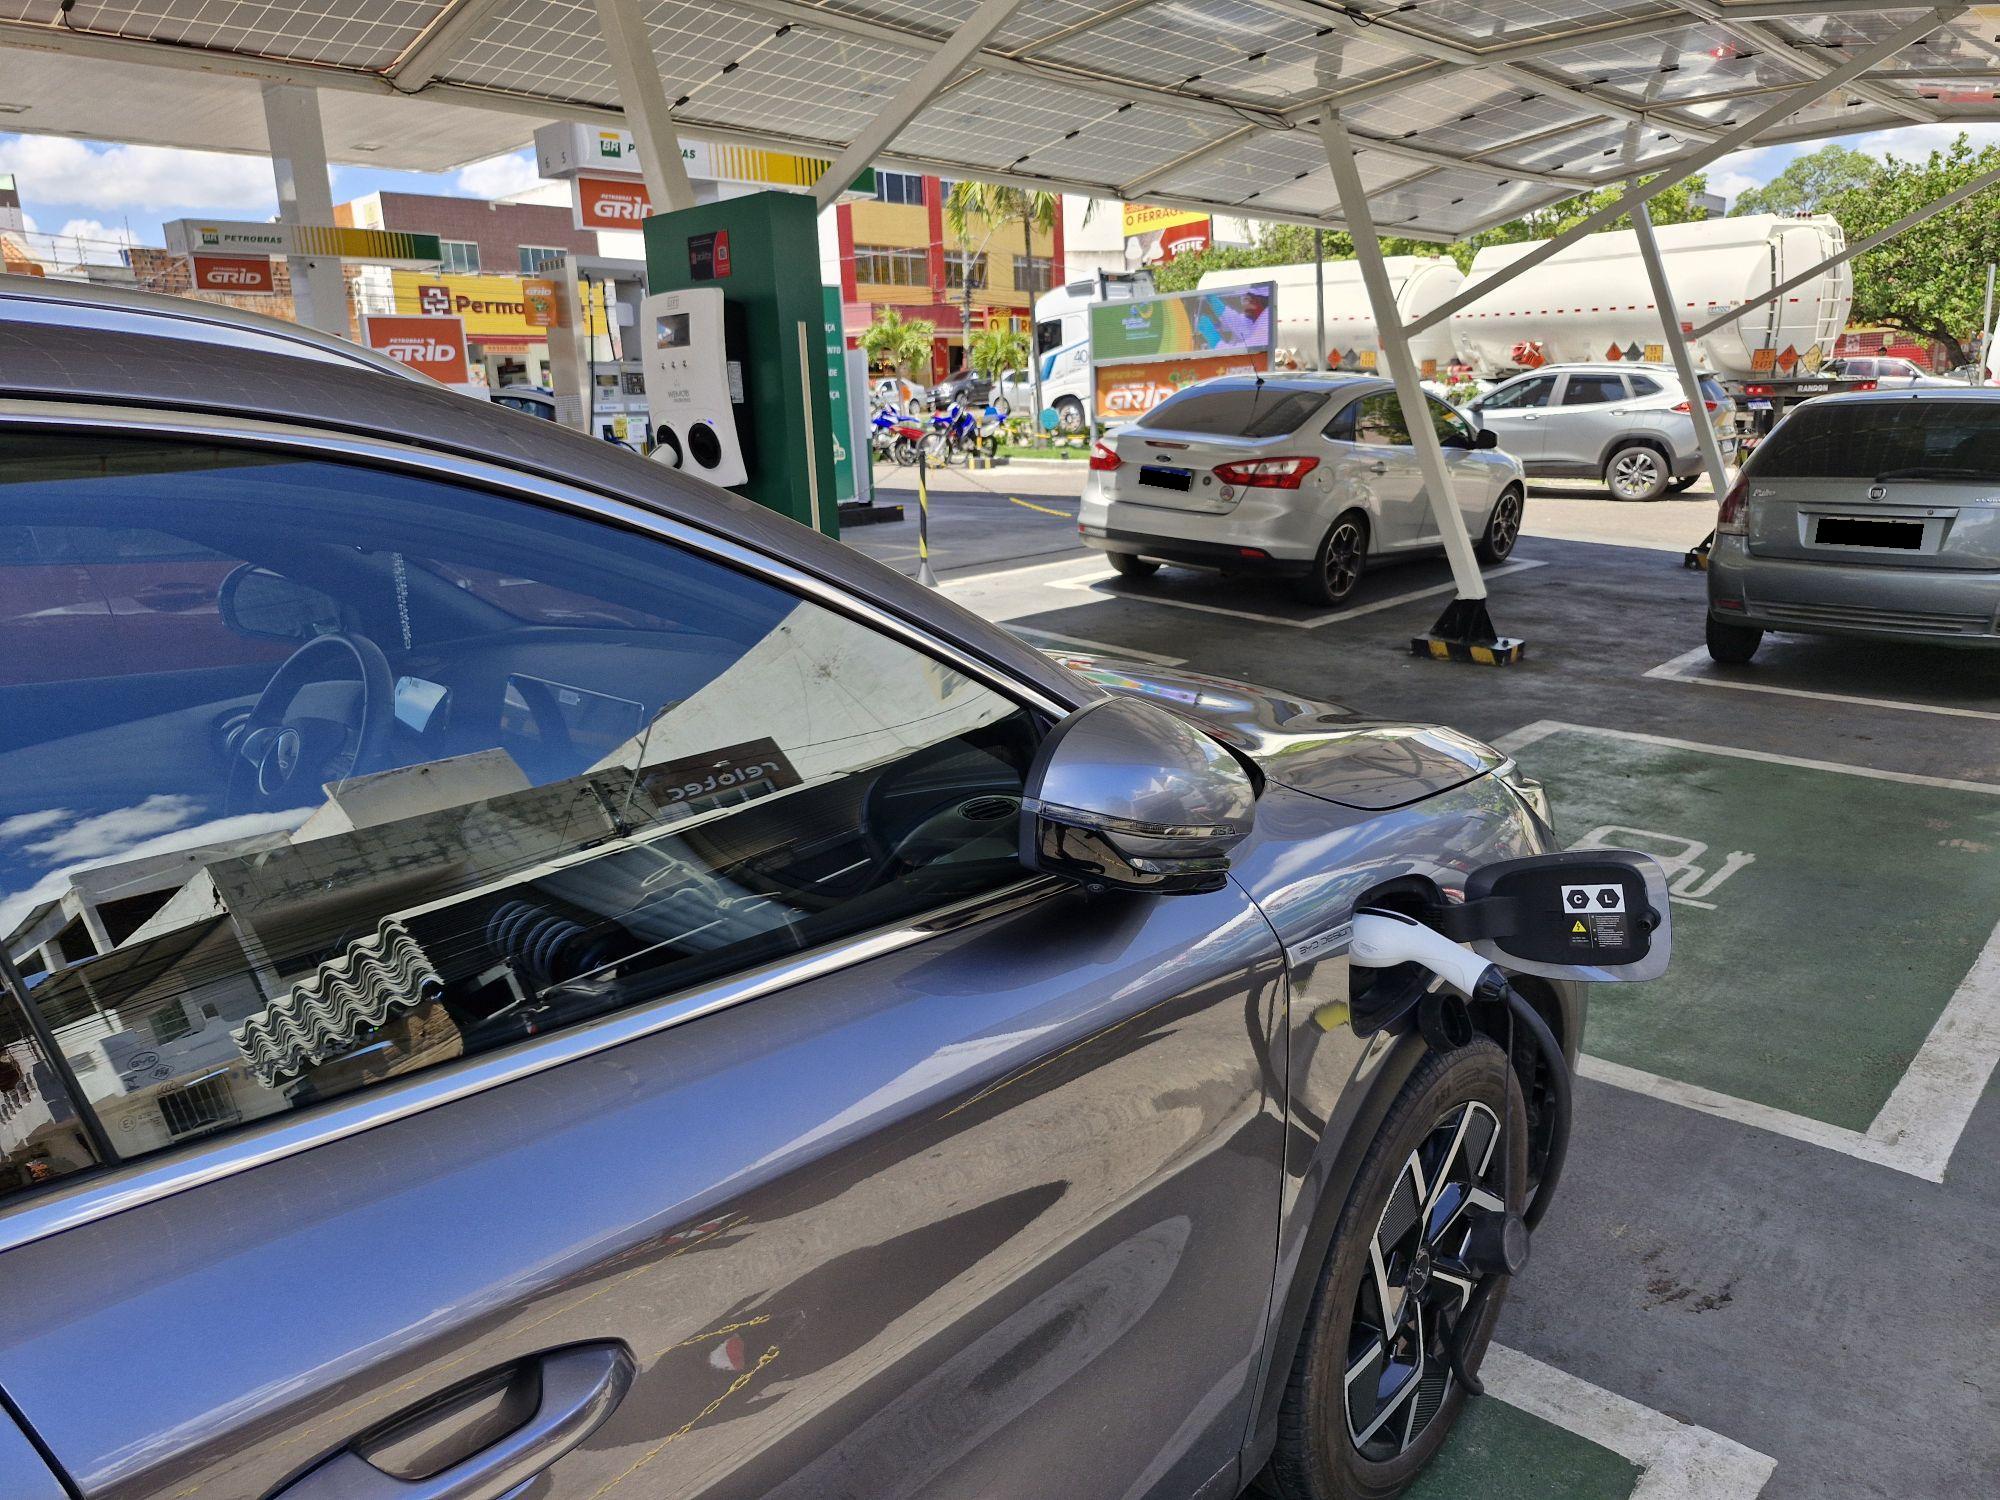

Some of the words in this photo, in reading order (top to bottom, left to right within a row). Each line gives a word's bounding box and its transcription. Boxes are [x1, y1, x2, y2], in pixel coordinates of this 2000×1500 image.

[224, 234, 282, 244] PETROBRAS
[207, 268, 261, 285] GRID
[389, 337, 425, 345] PETROBRAS
[384, 338, 456, 362] GRID
[1797, 384, 1829, 393] RANDON
[1573, 894, 1583, 904] C
[1604, 894, 1613, 904] L
[130, 1055, 156, 1069] BYD
